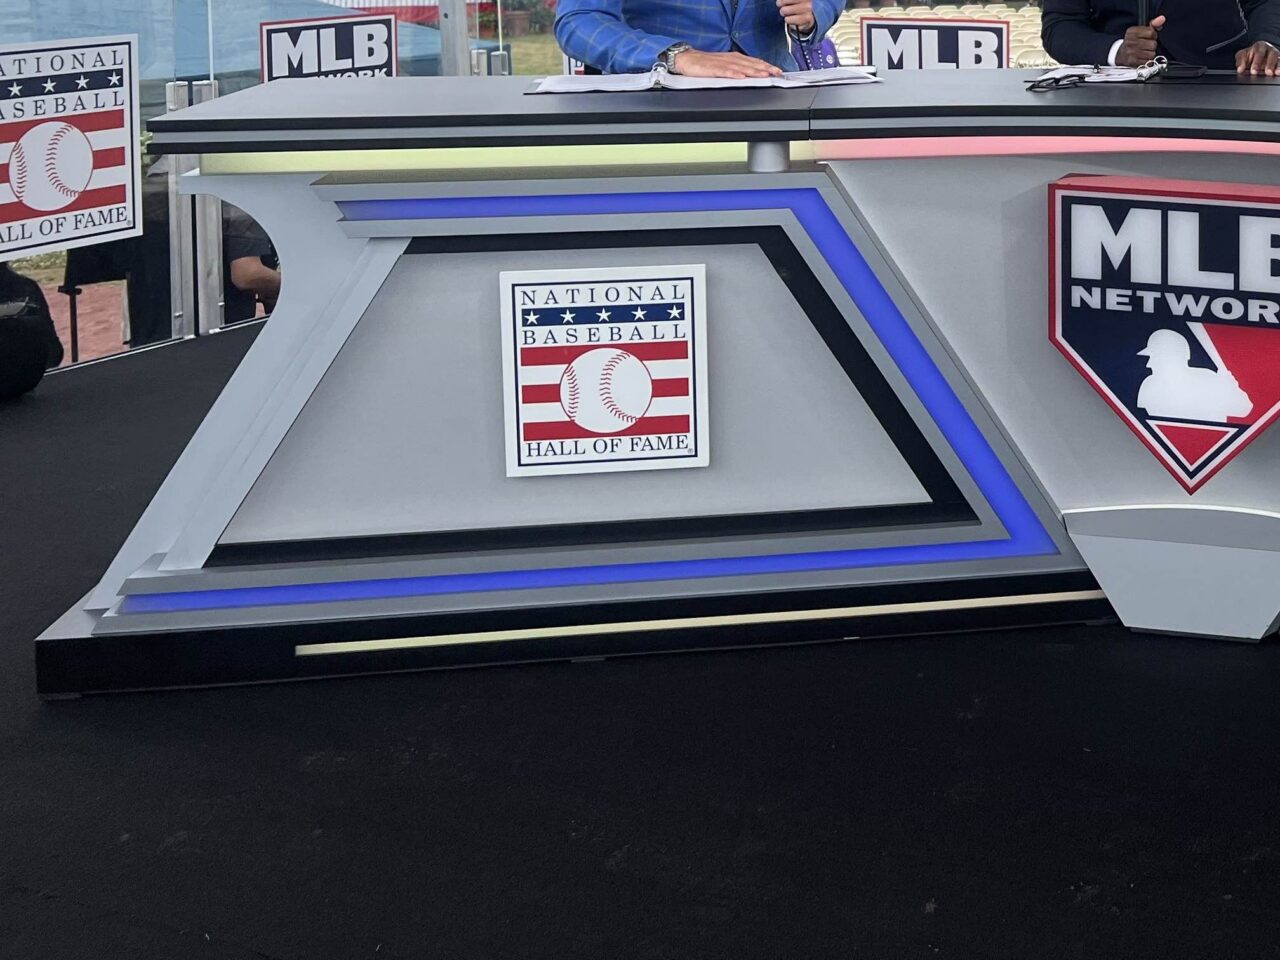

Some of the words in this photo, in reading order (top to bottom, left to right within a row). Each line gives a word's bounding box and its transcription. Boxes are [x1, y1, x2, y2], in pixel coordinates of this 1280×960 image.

[271, 23, 389, 78] MLB
[871, 27, 999, 70] MLB
[39, 216, 67, 236] OF
[73, 205, 128, 231] FAME
[520, 284, 685, 306] NATIONAL
[522, 324, 686, 345] BASEBALL
[526, 440, 586, 458] HALL
[593, 437, 623, 455] OF
[629, 434, 689, 453] FAME
